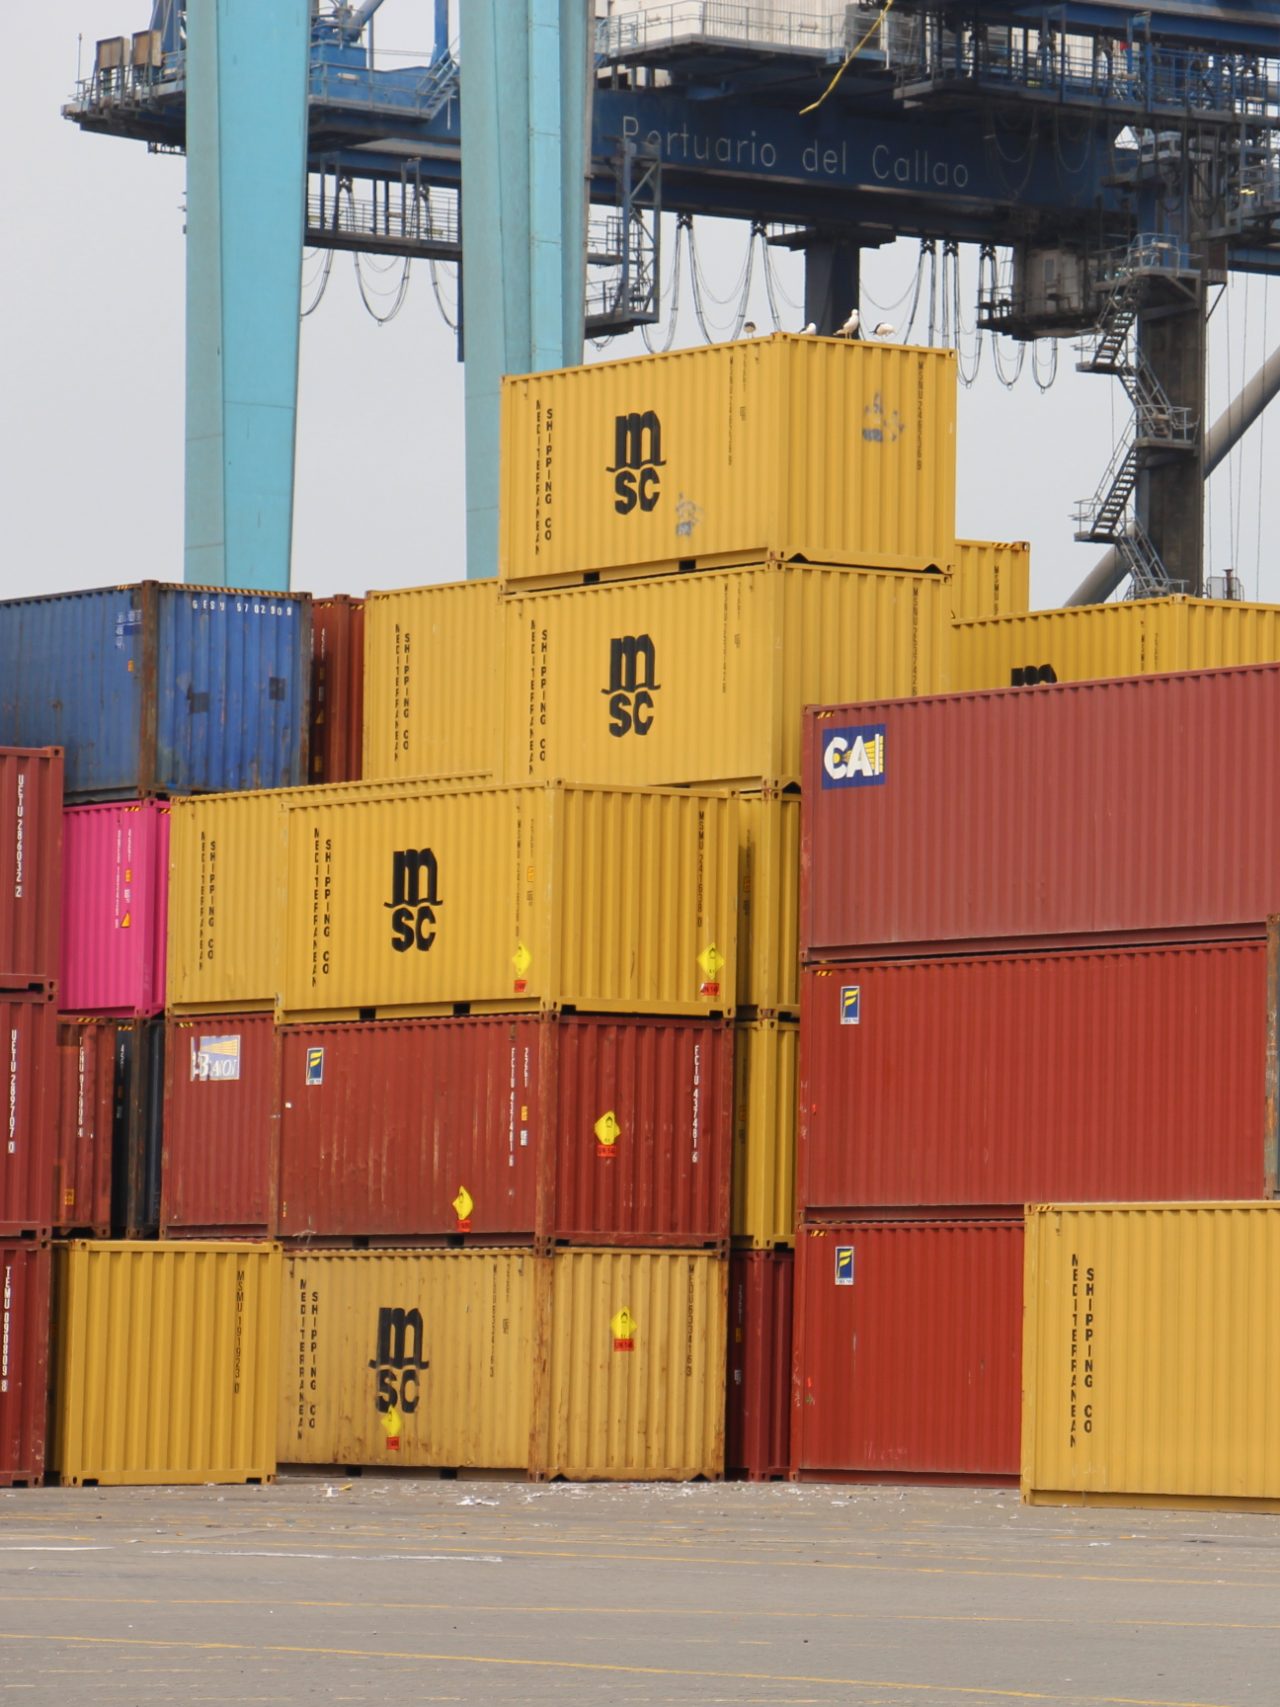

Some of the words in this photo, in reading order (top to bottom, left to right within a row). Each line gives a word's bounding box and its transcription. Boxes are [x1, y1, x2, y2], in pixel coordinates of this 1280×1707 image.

[802, 140, 847, 175] del
[872, 144, 969, 189] Callao
[824, 734, 880, 779] CAI
[4, 1266, 12, 1310] TEMU
[236, 1271, 245, 1313] MSMU
[309, 1291, 319, 1391] SHIPPING
[1084, 1267, 1095, 1388] SHIPPING
